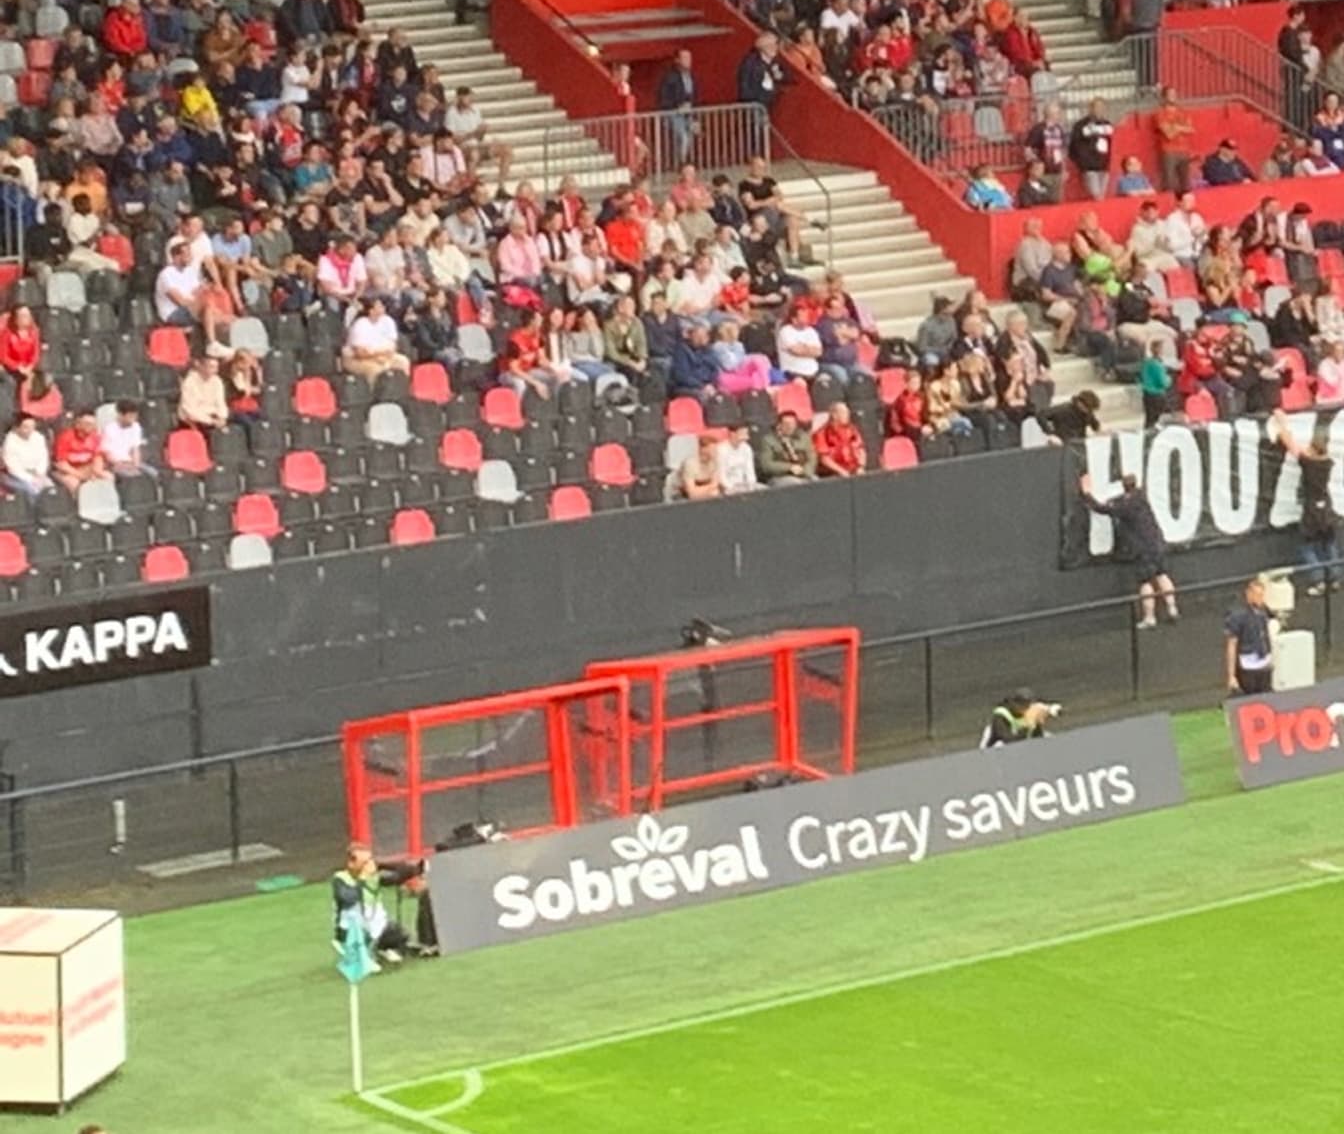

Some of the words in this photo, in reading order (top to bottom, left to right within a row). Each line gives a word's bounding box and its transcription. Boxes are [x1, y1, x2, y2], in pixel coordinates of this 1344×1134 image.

[25, 611, 189, 672] KAPPA
[493, 827, 769, 929] Sobreval
[788, 804, 932, 870] Crazy
[943, 762, 1136, 840] saveurs
